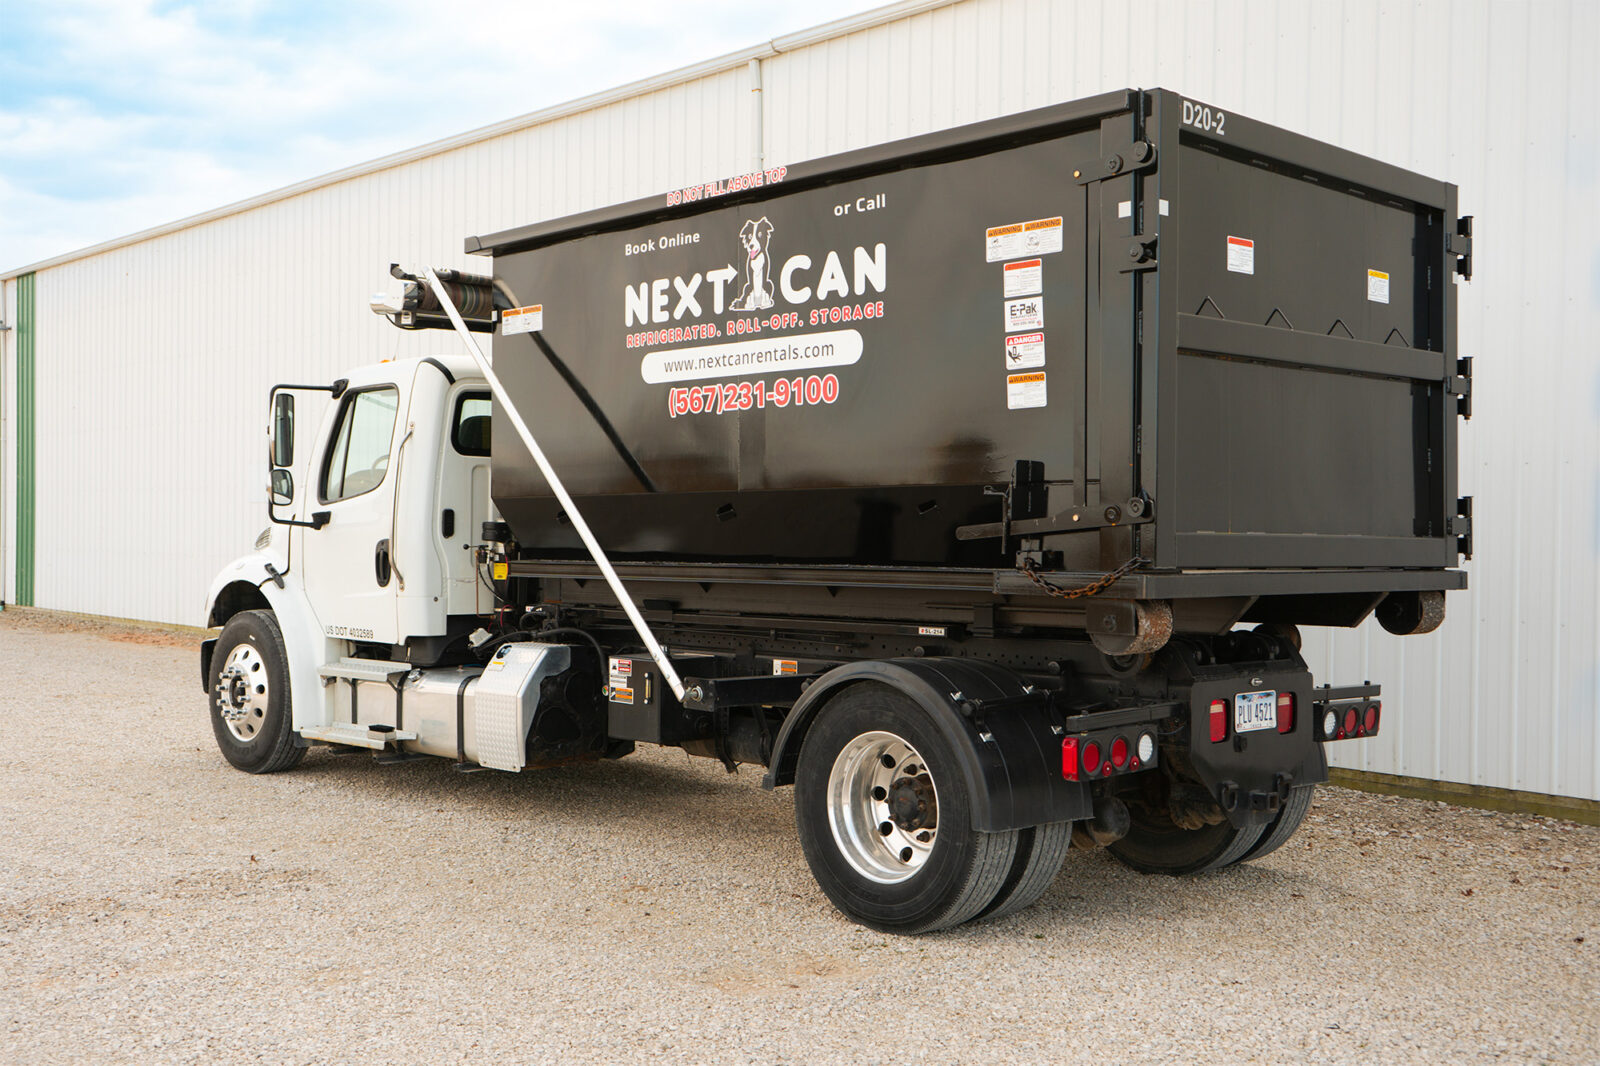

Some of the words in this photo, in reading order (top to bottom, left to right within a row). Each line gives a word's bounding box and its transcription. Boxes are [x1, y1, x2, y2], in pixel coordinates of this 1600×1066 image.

[1183, 100, 1225, 136] D20-2
[667, 191, 681, 207] DO
[682, 185, 704, 204] NOT
[704, 181, 727, 199] FILL
[726, 171, 764, 194] ABOVE
[764, 166, 788, 185] TOP
[833, 202, 851, 217] or
[856, 193, 886, 213] Call
[992, 225, 1022, 236] WARNING
[1029, 218, 1061, 230] WARNING
[625, 239, 655, 256] Book
[659, 232, 700, 250] Online
[625, 266, 737, 327] NEXT
[780, 243, 886, 304] CAN
[1010, 302, 1037, 316] E-Pak
[626, 324, 721, 348] REFRIGERATED.
[727, 312, 804, 335] ROLL-OFF.
[810, 302, 885, 326] STORAGE
[1013, 335, 1042, 345] DANGER
[664, 342, 835, 373] www.nextcanrentals.com
[1013, 373, 1045, 383] WARNING
[668, 373, 840, 417] (567)231-9100
[335, 626, 348, 636] DOT
[1238, 704, 1252, 724] PLU
[1255, 702, 1273, 722] 4521
